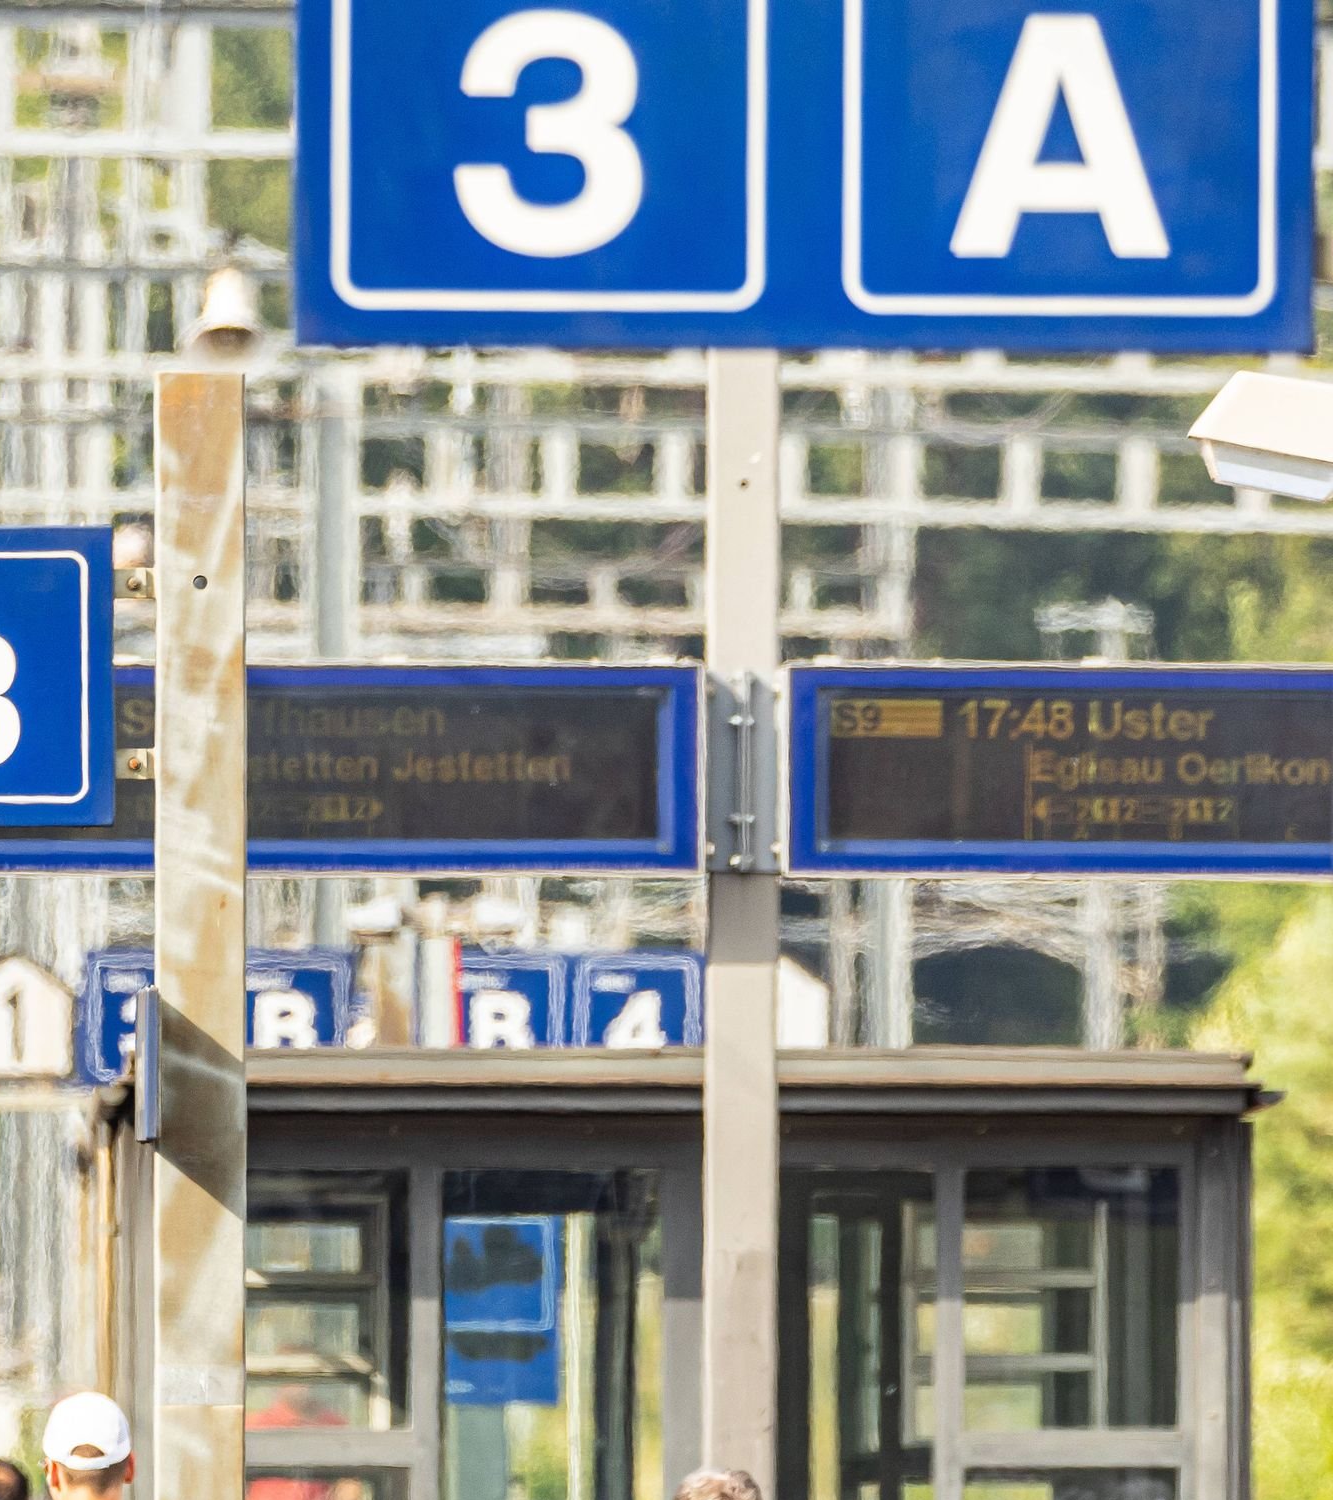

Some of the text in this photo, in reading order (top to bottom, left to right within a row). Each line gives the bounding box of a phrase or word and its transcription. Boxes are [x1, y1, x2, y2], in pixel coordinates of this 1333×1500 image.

[453, 10, 644, 258] 3
[948, 12, 1171, 259] A
[957, 699, 1075, 741] 17:48
[1088, 699, 1214, 741] Uster
[602, 989, 668, 1049] 4
